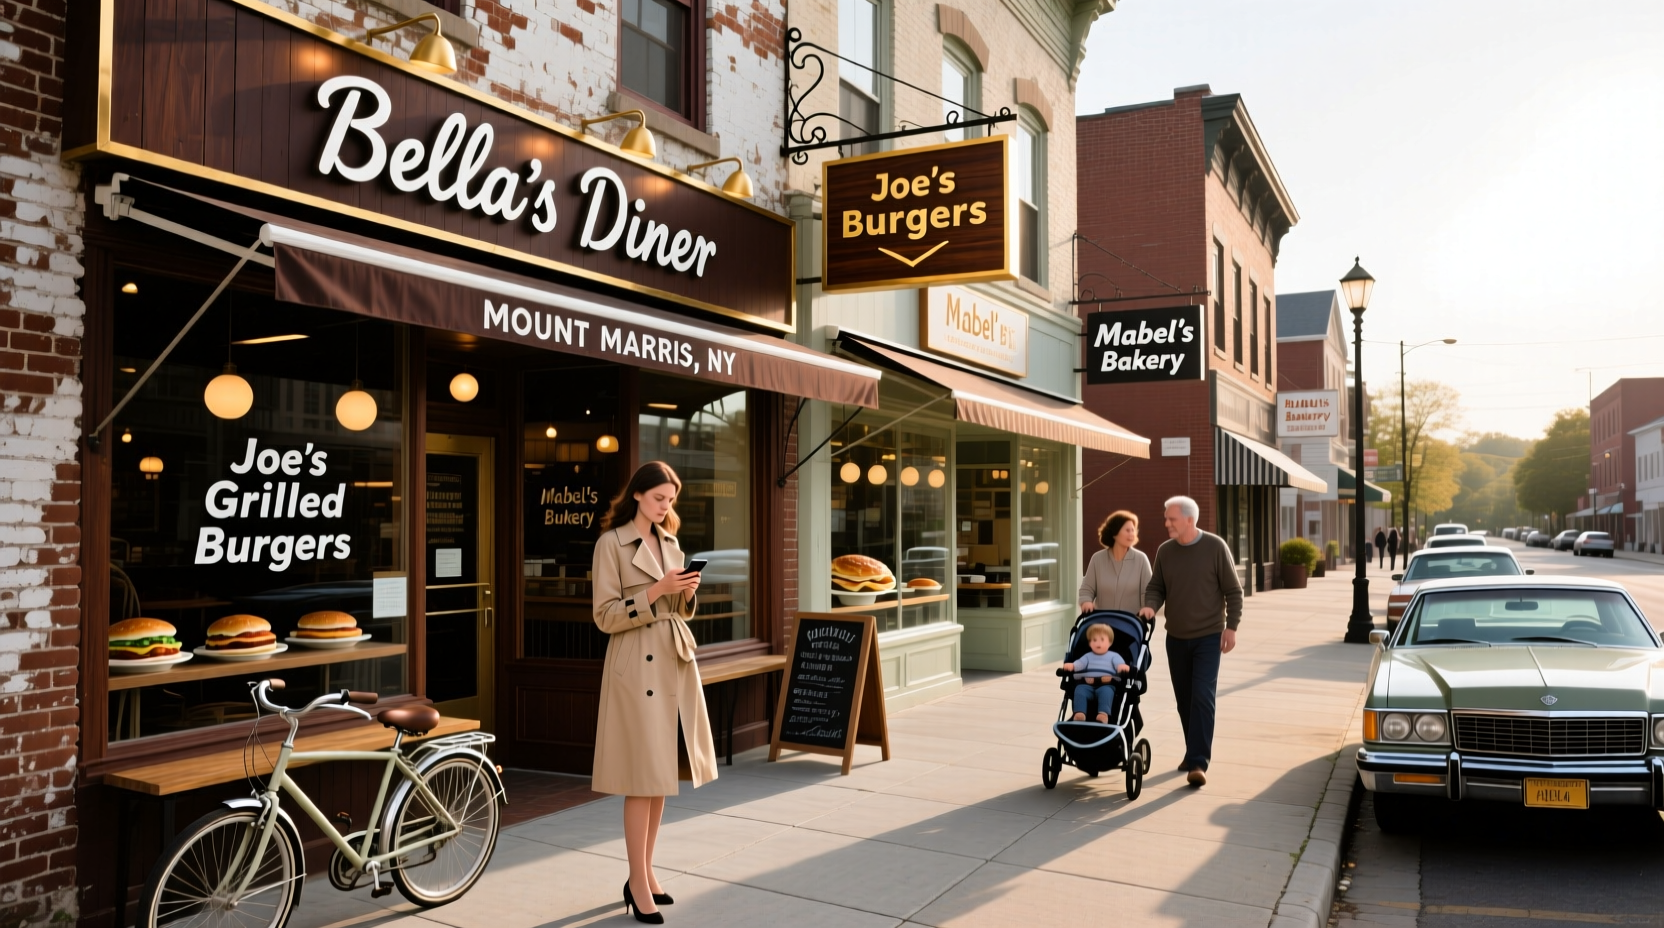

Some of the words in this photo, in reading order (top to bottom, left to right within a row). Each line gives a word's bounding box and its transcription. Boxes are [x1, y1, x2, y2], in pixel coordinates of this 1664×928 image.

[317, 75, 558, 233] Bella's
[580, 166, 717, 278] Diner
[870, 165, 955, 202] Joe's
[842, 201, 988, 241] Burgers
[483, 298, 590, 348] MOUNT
[600, 325, 700, 375] MARRIS,
[707, 347, 738, 377] NY
[1093, 316, 1195, 348] Mabel's
[1100, 348, 1186, 376] Bakery
[229, 437, 328, 477] Joe's
[205, 481, 347, 520] Grilled
[194, 526, 351, 572] Burgers
